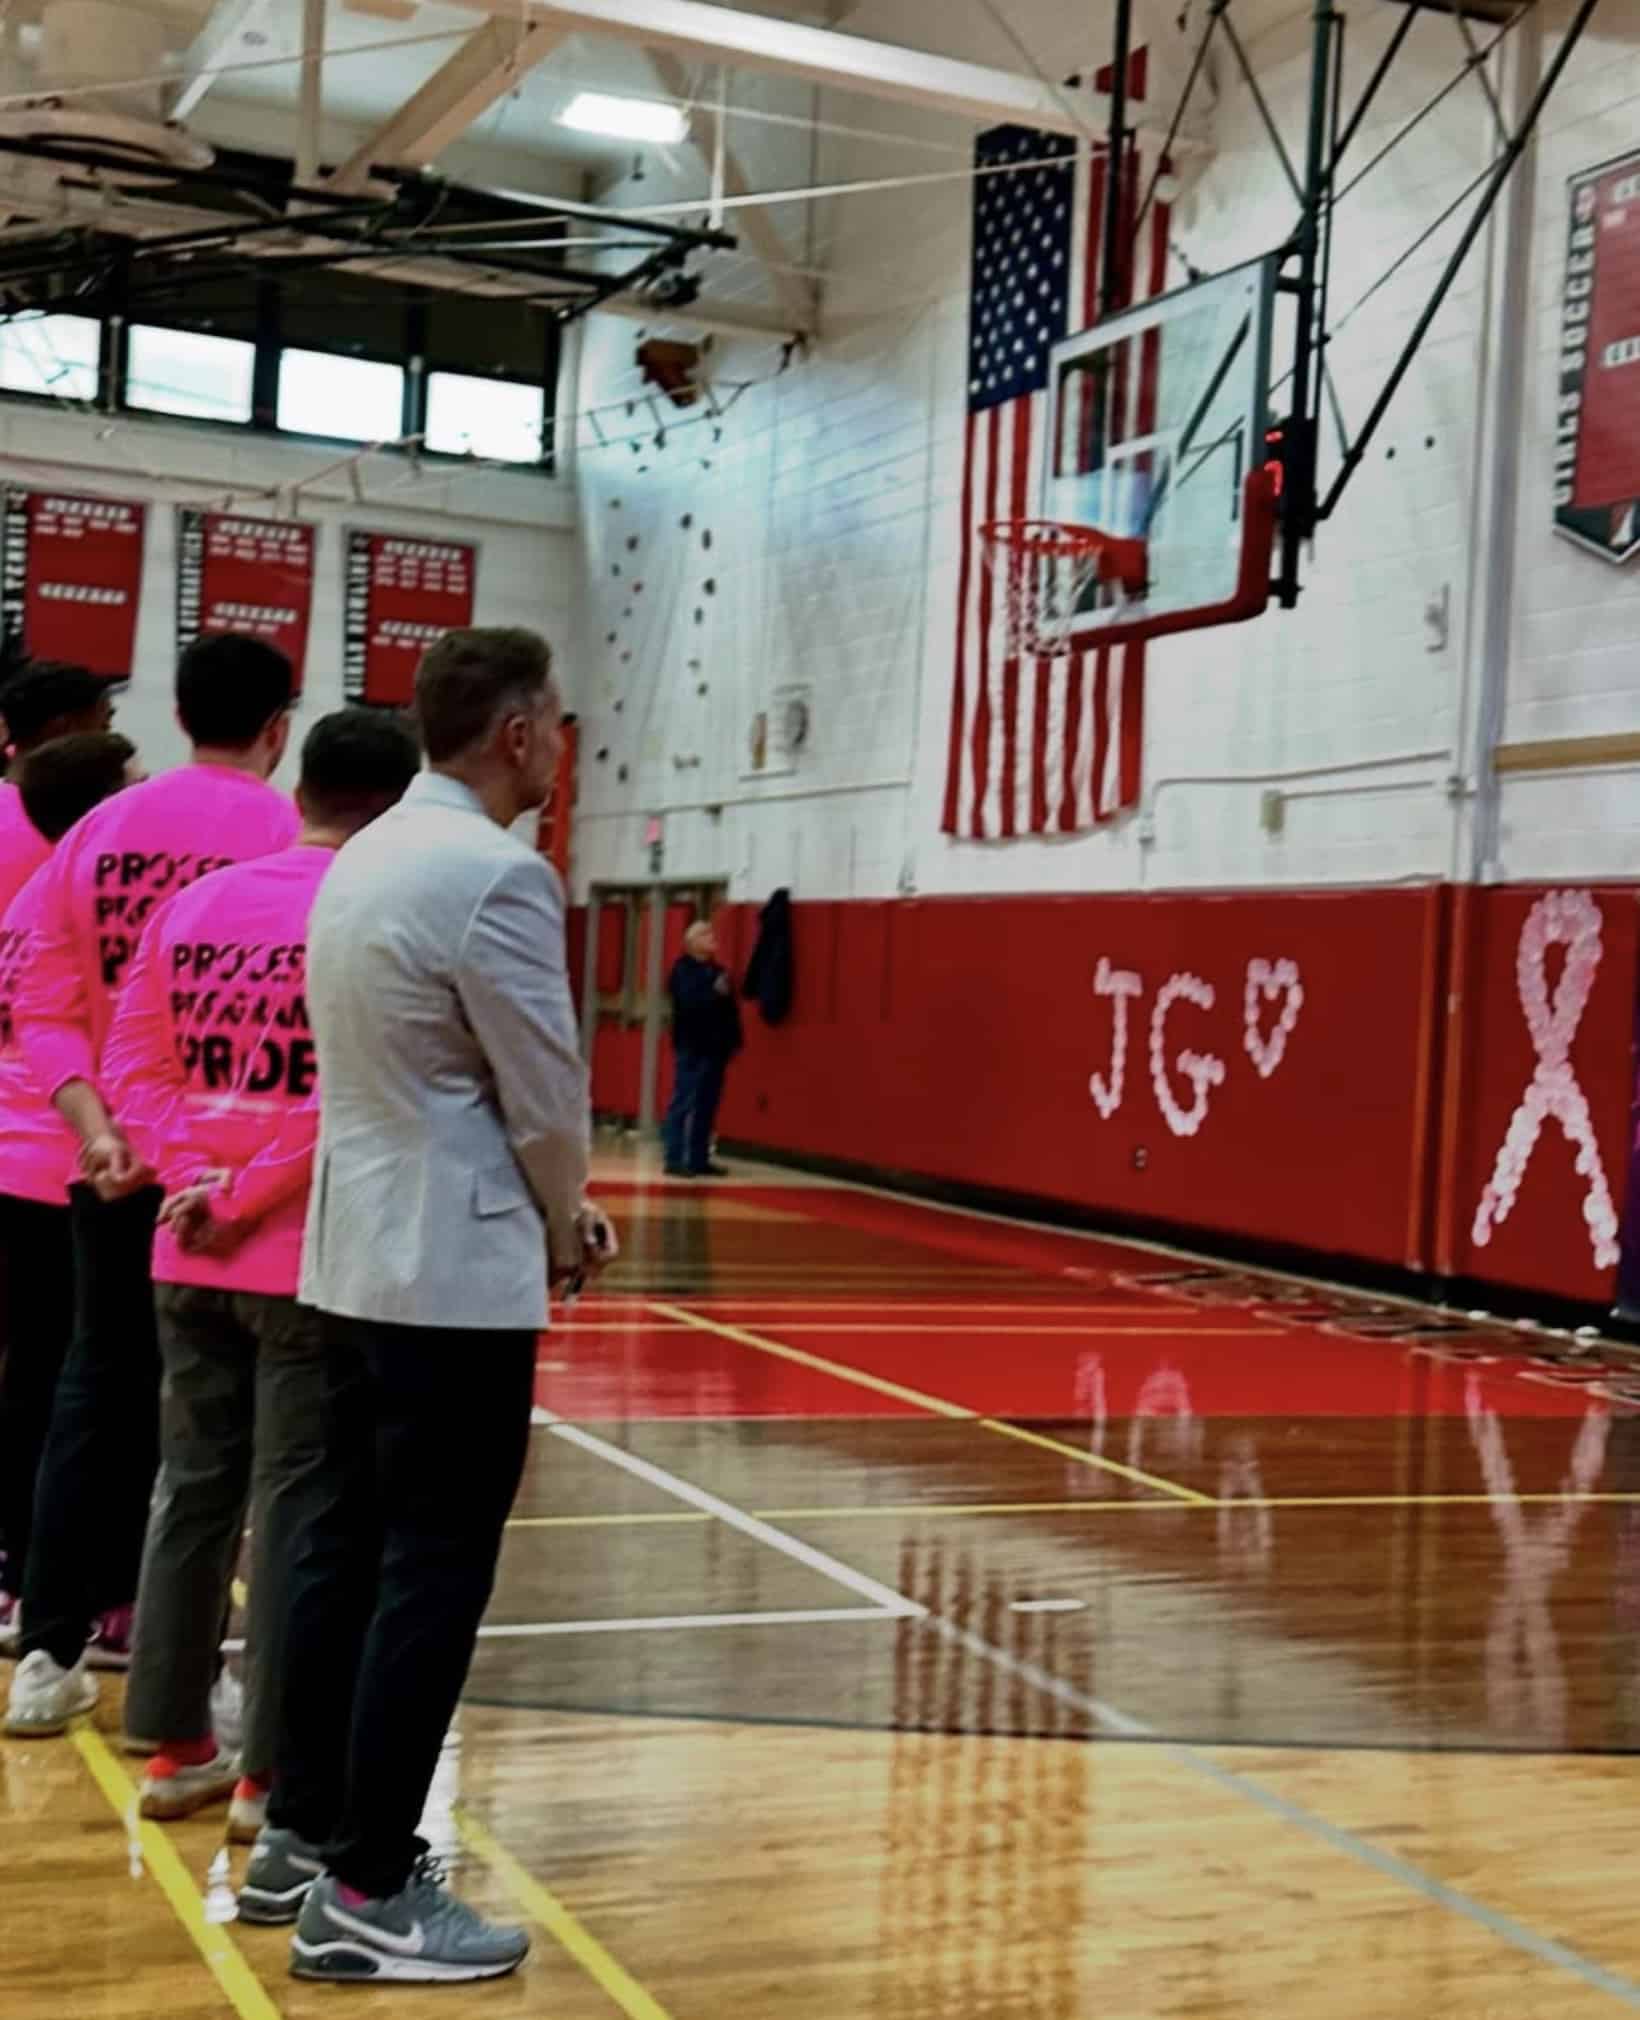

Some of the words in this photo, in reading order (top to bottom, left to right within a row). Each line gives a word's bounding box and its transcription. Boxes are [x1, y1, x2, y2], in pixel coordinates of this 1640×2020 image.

[1560, 226, 1596, 372] SOCCER
[1551, 390, 1580, 506] GIRLS
[175, 1035, 318, 1094] PRIDE
